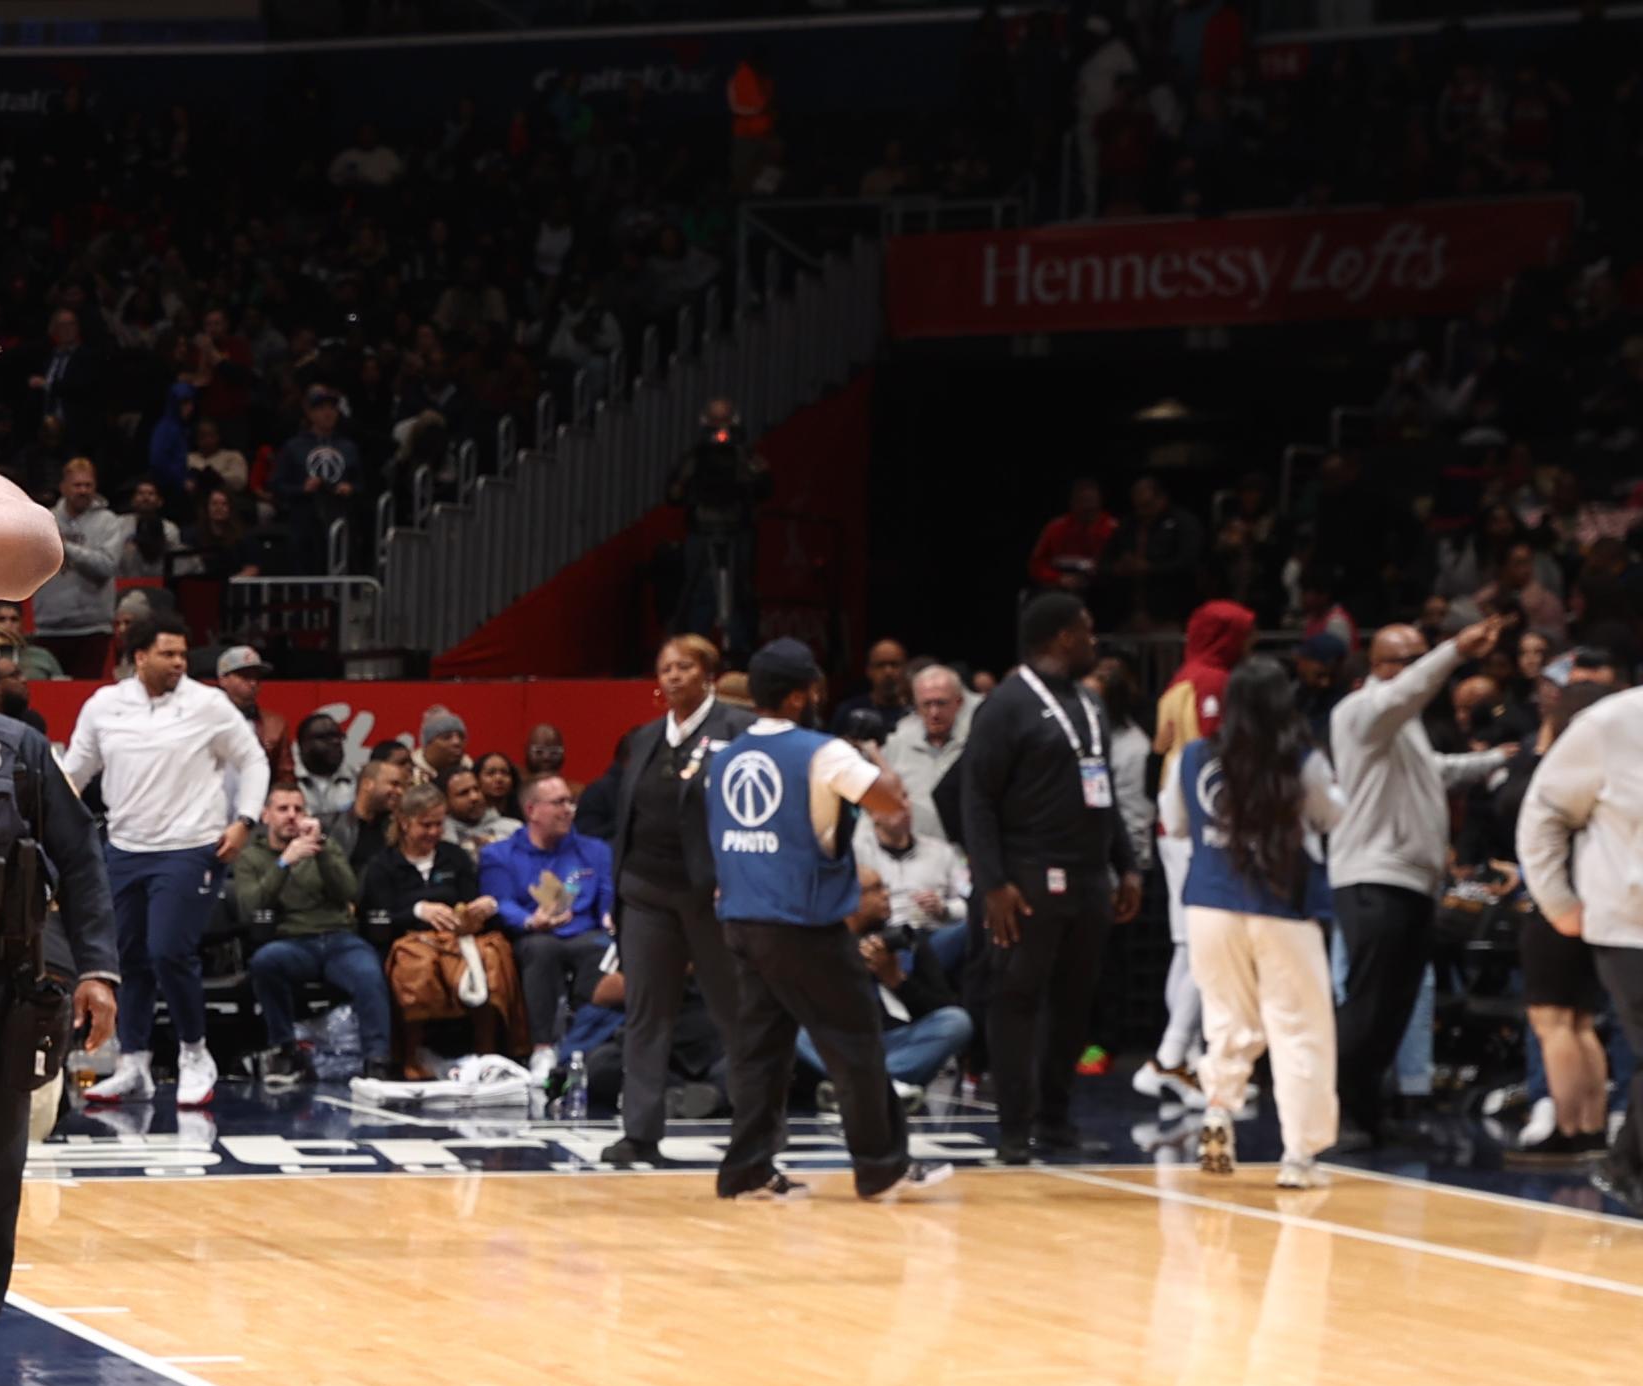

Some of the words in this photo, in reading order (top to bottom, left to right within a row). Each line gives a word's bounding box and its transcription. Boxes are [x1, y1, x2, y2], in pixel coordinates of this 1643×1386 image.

[981, 242, 1287, 312] Hennessy
[1289, 220, 1454, 304] Lofts
[721, 829, 780, 854] PHOTO
